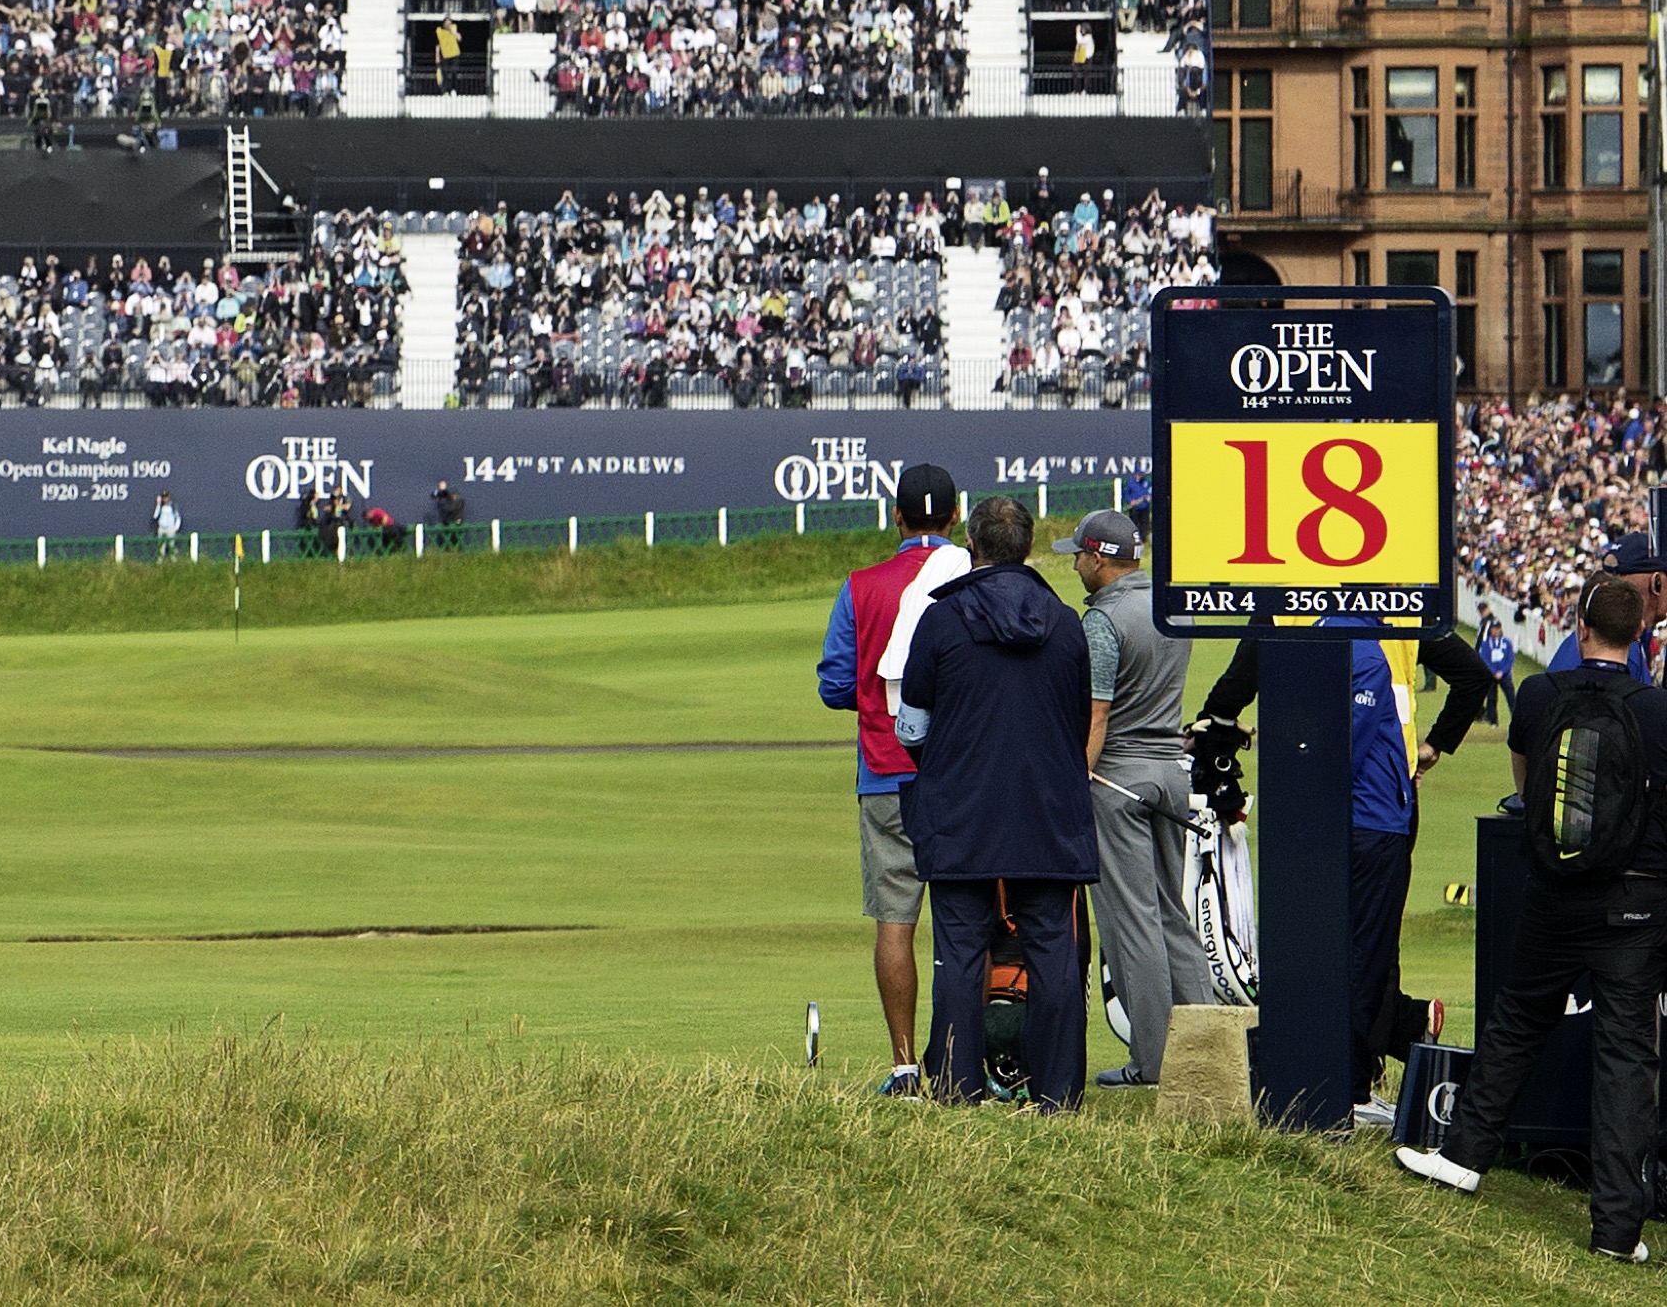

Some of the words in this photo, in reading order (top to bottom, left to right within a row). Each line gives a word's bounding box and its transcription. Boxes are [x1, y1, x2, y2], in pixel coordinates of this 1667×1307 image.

[1271, 323, 1335, 348] THE
[1230, 343, 1377, 393] OPEN
[1278, 396, 1292, 405] ST
[1295, 396, 1353, 405] ANDREWS
[42, 436, 74, 454] Kel
[76, 436, 127, 460] Nagle
[281, 436, 338, 461] THE
[811, 437, 868, 461] THE
[45, 458, 129, 482] Champion
[132, 460, 171, 478] 1960
[537, 456, 565, 474] ST
[570, 456, 685, 474] ANDREWS
[1070, 456, 1098, 475] ST
[245, 454, 374, 501] OPEN
[774, 454, 904, 502] OPEN
[42, 483, 79, 501] 1920
[91, 483, 128, 501] 2015
[1224, 438, 1388, 567] 18
[1185, 590, 1235, 612] PAR
[1239, 590, 1256, 612] 4
[1285, 590, 1328, 612] 356
[1333, 590, 1424, 613] YARDS
